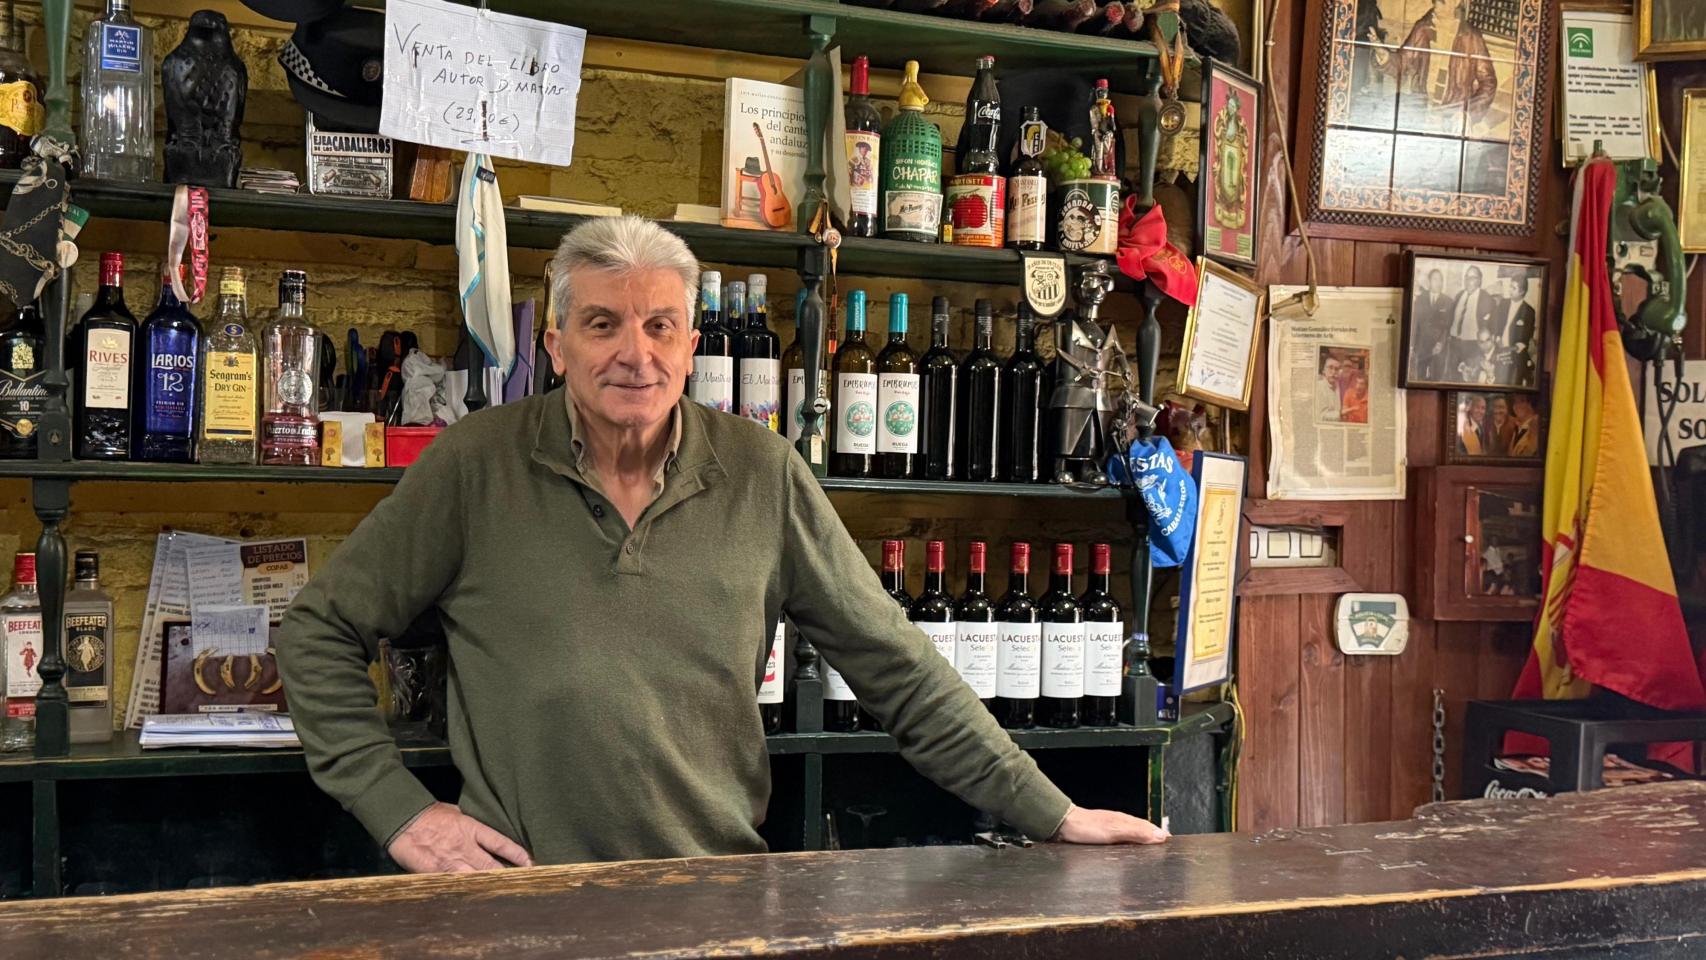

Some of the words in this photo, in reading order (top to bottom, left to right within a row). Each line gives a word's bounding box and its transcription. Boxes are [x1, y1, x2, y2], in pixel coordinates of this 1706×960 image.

[393, 23, 453, 60] VENTA
[464, 51, 493, 67] DEL
[432, 68, 484, 86] AUTOR
[514, 84, 566, 96] MATIAS
[740, 103, 759, 115] Los
[762, 108, 808, 123] principio
[766, 121, 782, 132] del
[313, 135, 333, 146] EJEA
[332, 136, 390, 153] CABALLEROS
[770, 135, 809, 150] andaluz
[89, 350, 128, 364] RIVES
[152, 353, 193, 370] LARIOS
[157, 372, 184, 392] 12
[209, 368, 253, 383] Seagram's
[214, 383, 231, 392] DRY
[232, 383, 247, 393] GIN
[19, 400, 30, 411] 10
[1678, 418, 1706, 439] SO
[1129, 452, 1174, 474] ESTAS
[255, 543, 296, 554] LISTADO
[247, 555, 261, 564] DE
[263, 552, 304, 563] PRECIOS
[8, 620, 42, 633] BEEFEAT
[66, 615, 108, 628] BEEFEATER
[959, 633, 996, 643] LACUEST
[1047, 633, 1085, 643] LACUEST
[1089, 633, 1123, 643] LACUEST
